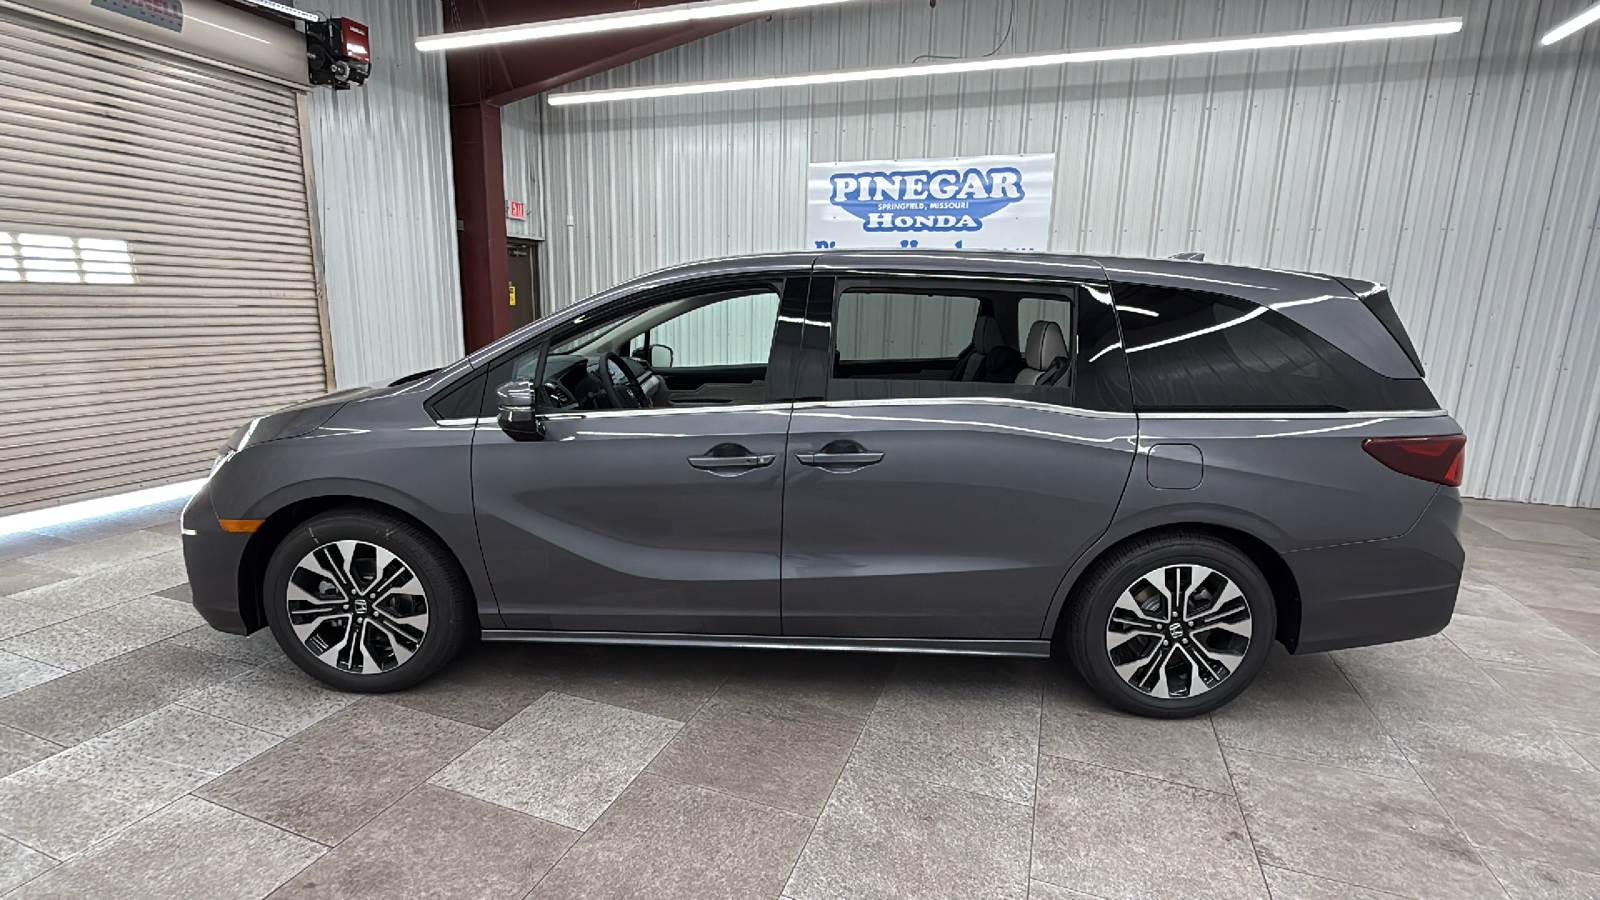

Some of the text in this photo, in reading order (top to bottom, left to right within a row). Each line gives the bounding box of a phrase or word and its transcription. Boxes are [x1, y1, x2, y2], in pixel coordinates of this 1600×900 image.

[833, 171, 1021, 201] PINEGAR
[511, 201, 524, 218] EXIT
[878, 201, 969, 211] SPRINGFIELD, MISSOURI
[867, 212, 978, 228] HONDA
